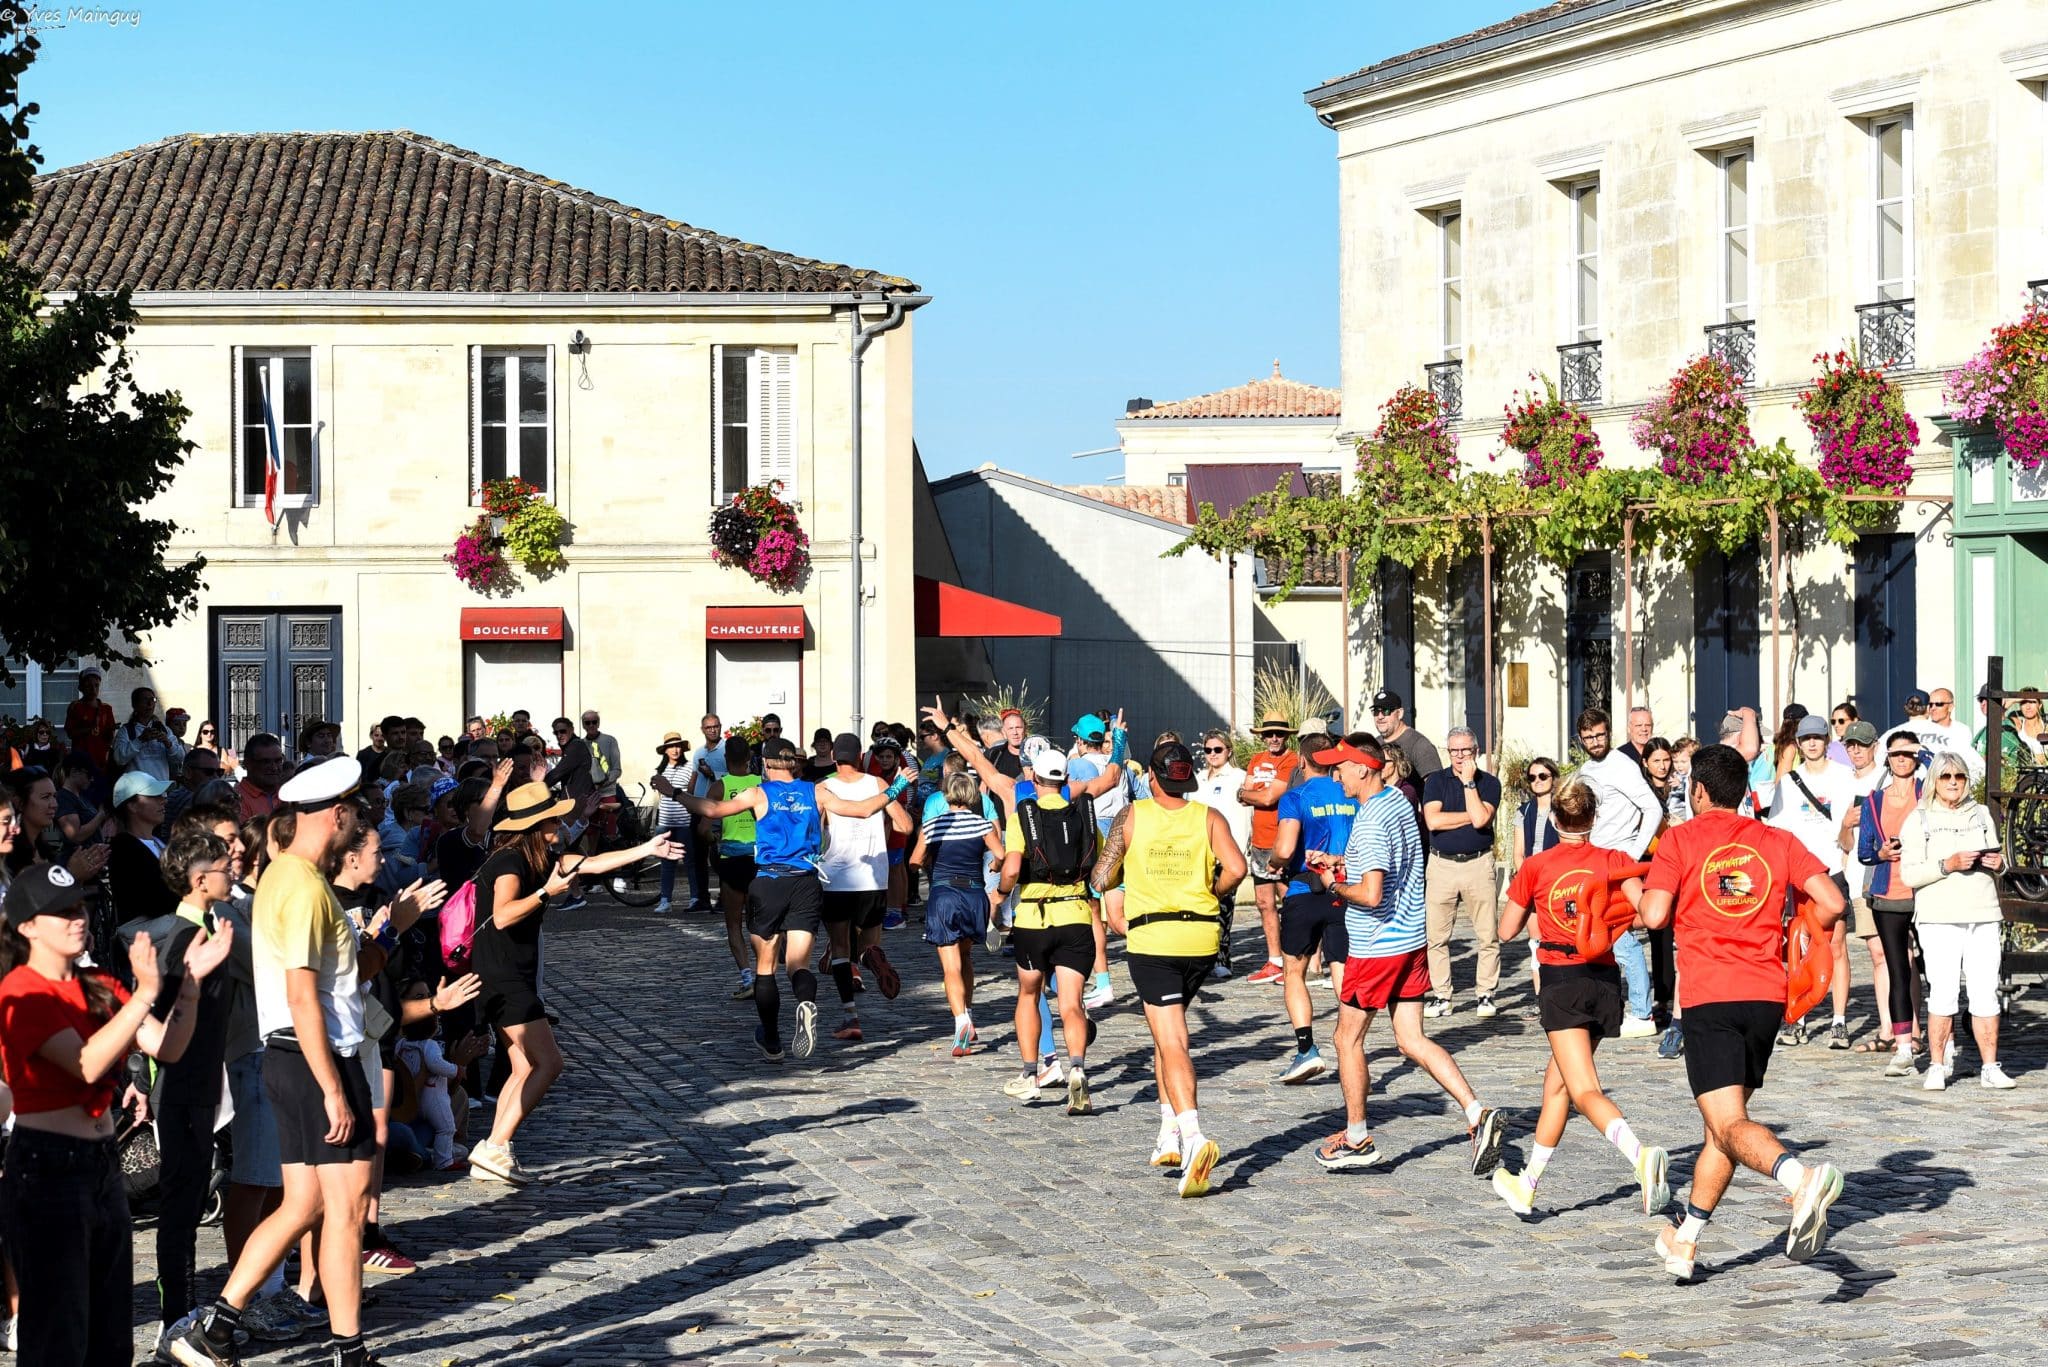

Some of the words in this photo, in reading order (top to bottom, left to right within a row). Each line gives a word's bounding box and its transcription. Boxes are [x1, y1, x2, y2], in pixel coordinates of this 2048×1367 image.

[473, 626, 549, 635] BOUCHERIE
[710, 625, 801, 634] CHARCUTERIE
[1025, 804, 1039, 841] SALOMON
[1706, 854, 1757, 874] BAYWATCH
[1552, 882, 1580, 900] BAYW
[1717, 897, 1758, 906] LIFEGUARD
